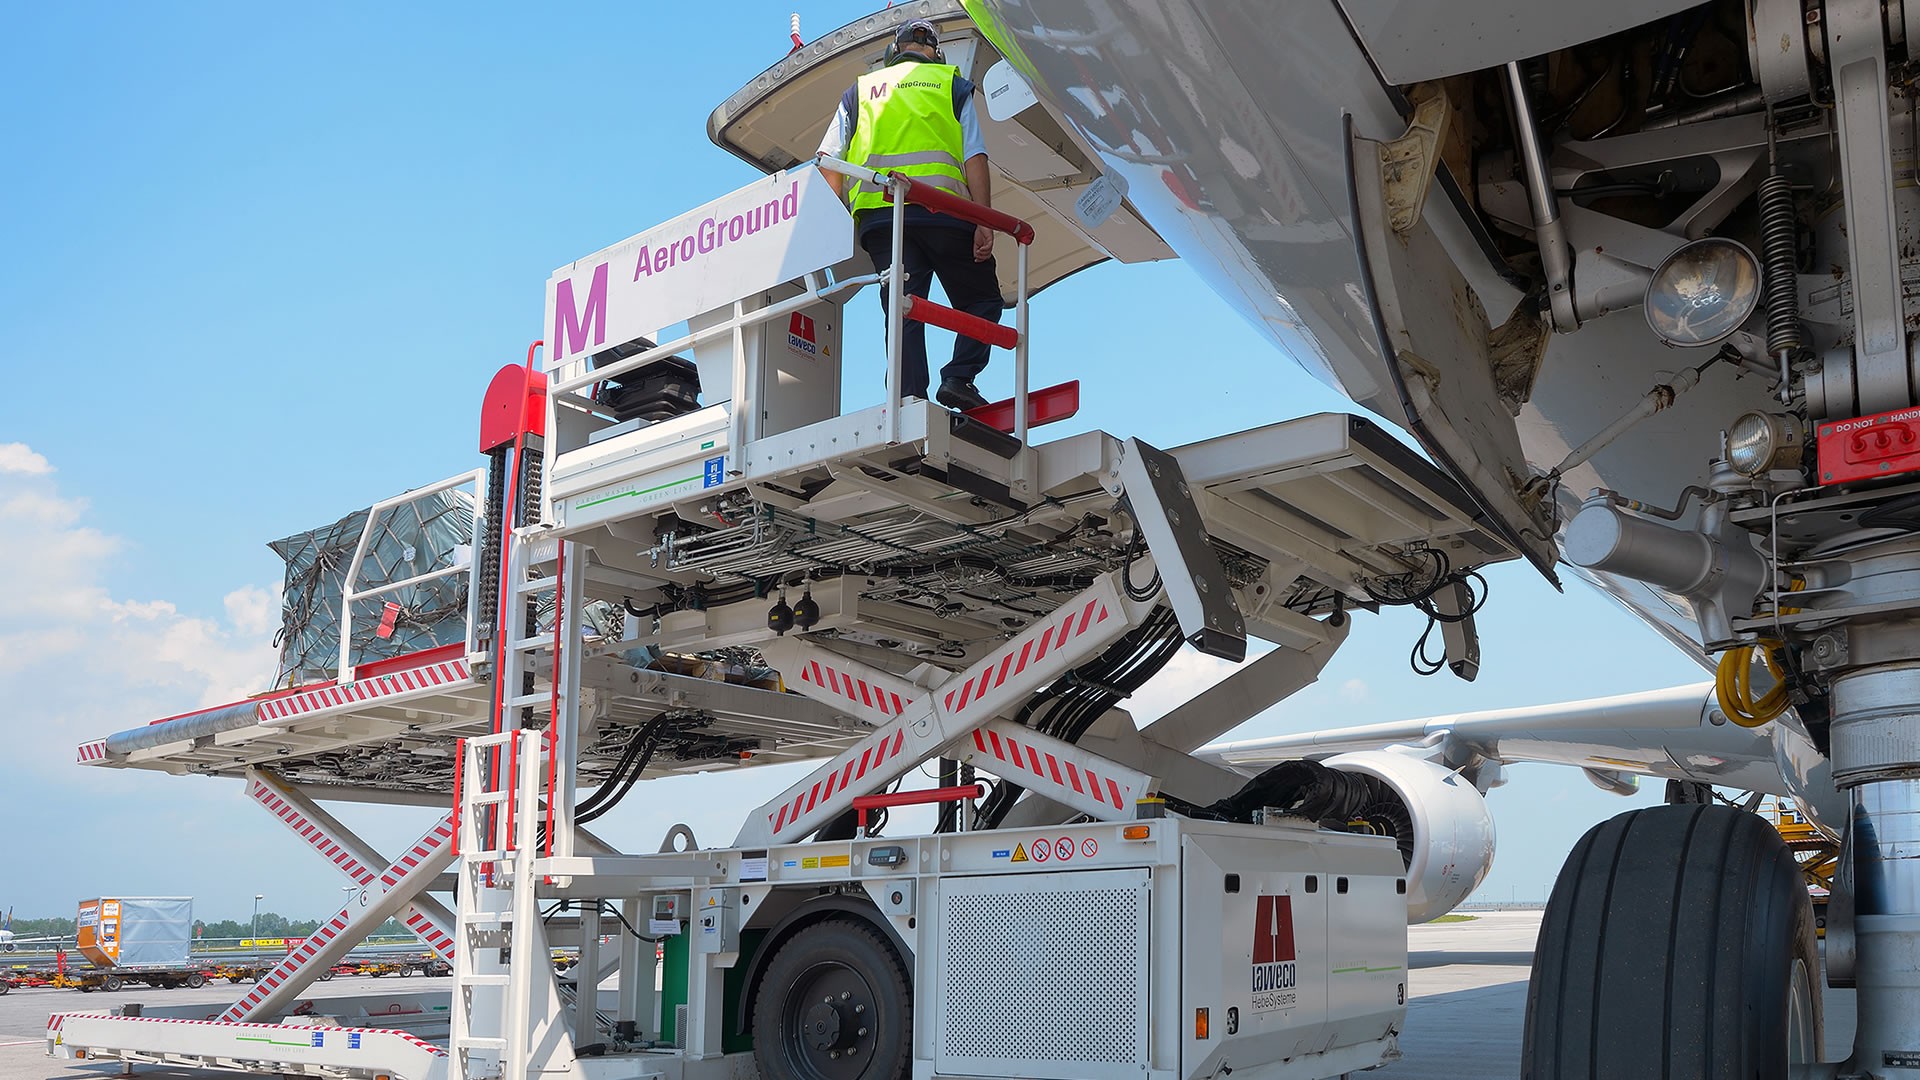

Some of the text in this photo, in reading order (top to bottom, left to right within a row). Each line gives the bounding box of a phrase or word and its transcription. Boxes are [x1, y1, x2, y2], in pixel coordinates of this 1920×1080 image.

[870, 81, 942, 100] M AeroGround
[553, 181, 799, 361] M AeroGround
[1836, 423, 1851, 433] DO
[1853, 419, 1874, 430] NOT
[575, 494, 601, 505] CARGO
[1252, 993, 1296, 1009] HebeSysteme
